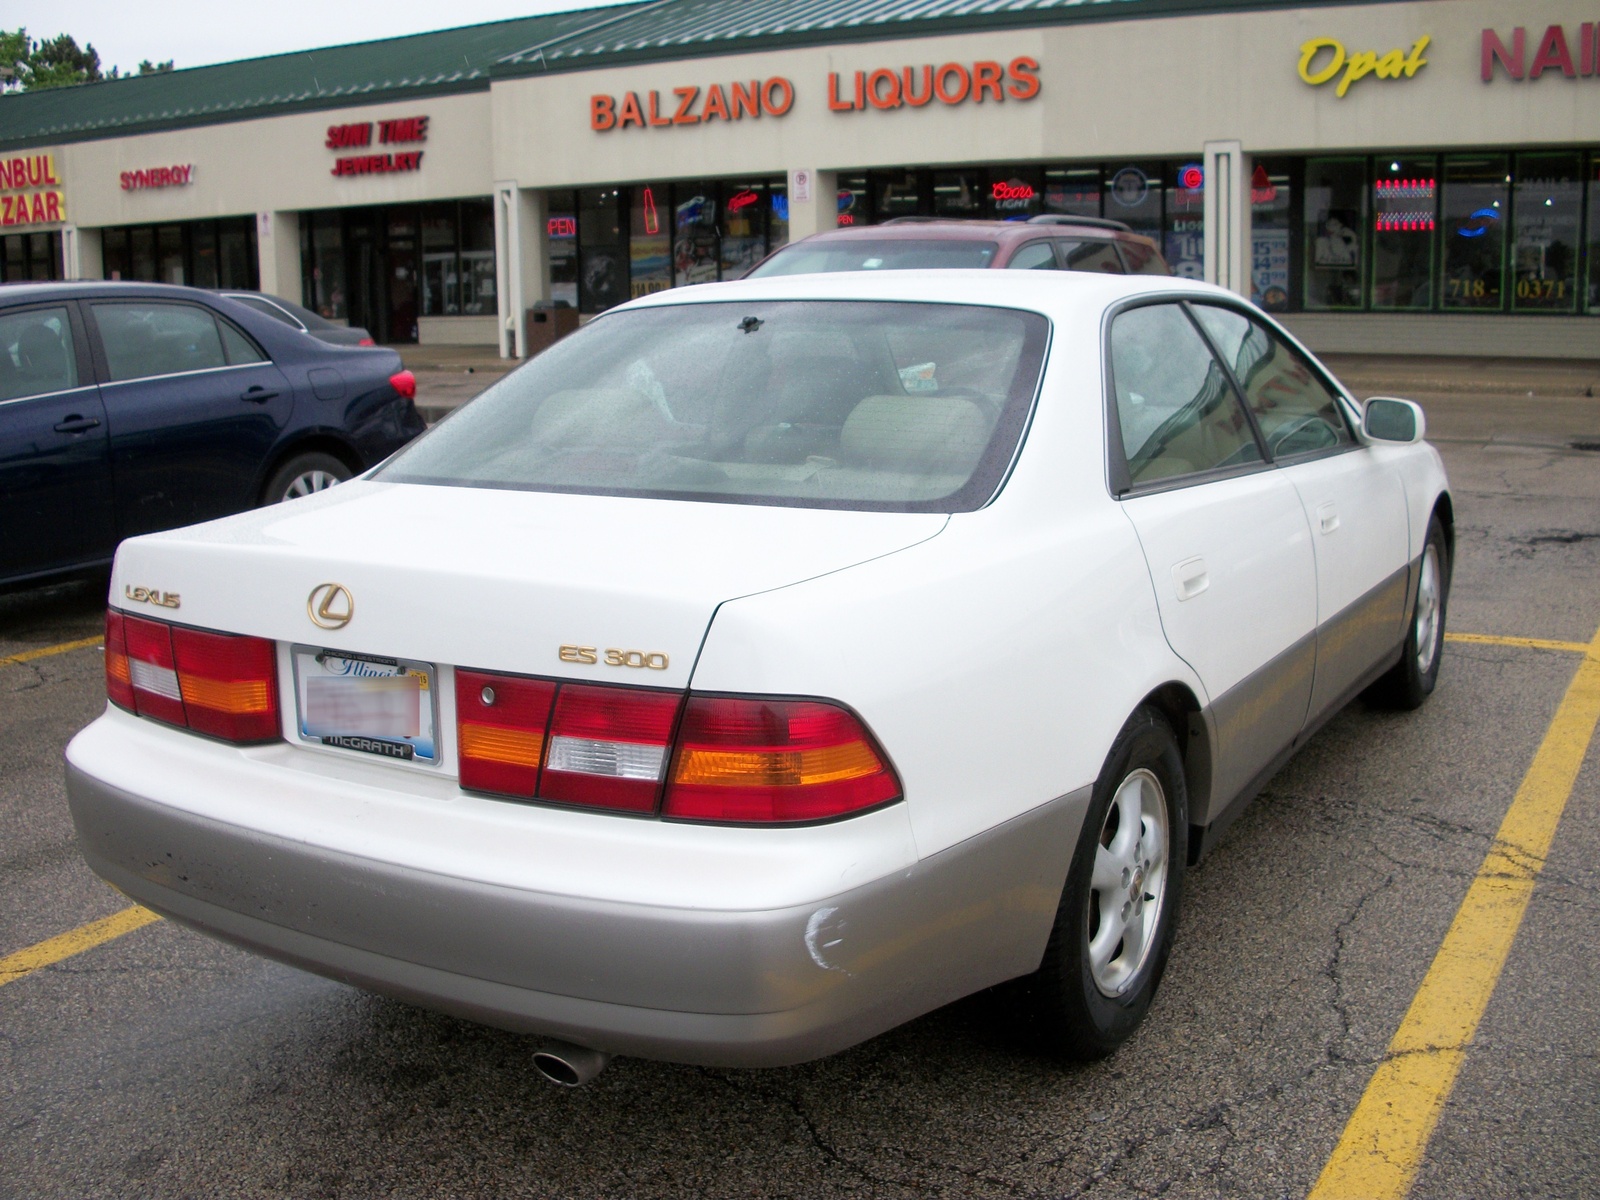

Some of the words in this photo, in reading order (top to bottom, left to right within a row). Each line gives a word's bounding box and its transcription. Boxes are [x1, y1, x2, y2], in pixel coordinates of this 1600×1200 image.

[1481, 22, 1600, 80] NAI
[590, 76, 794, 131] BALZANO
[827, 56, 1040, 112] LIQUORS
[378, 116, 427, 144] TIME
[331, 151, 421, 176] JEWELRY
[120, 163, 193, 191] SYNERGY
[992, 182, 1035, 199] Coors
[0, 191, 60, 225] ZAAR
[995, 198, 1030, 210] LIGHT
[547, 217, 576, 236] PEN
[125, 584, 181, 609] LEXUS
[324, 659, 399, 677] Illinoi
[558, 644, 598, 665] ES
[604, 647, 669, 671] 300
